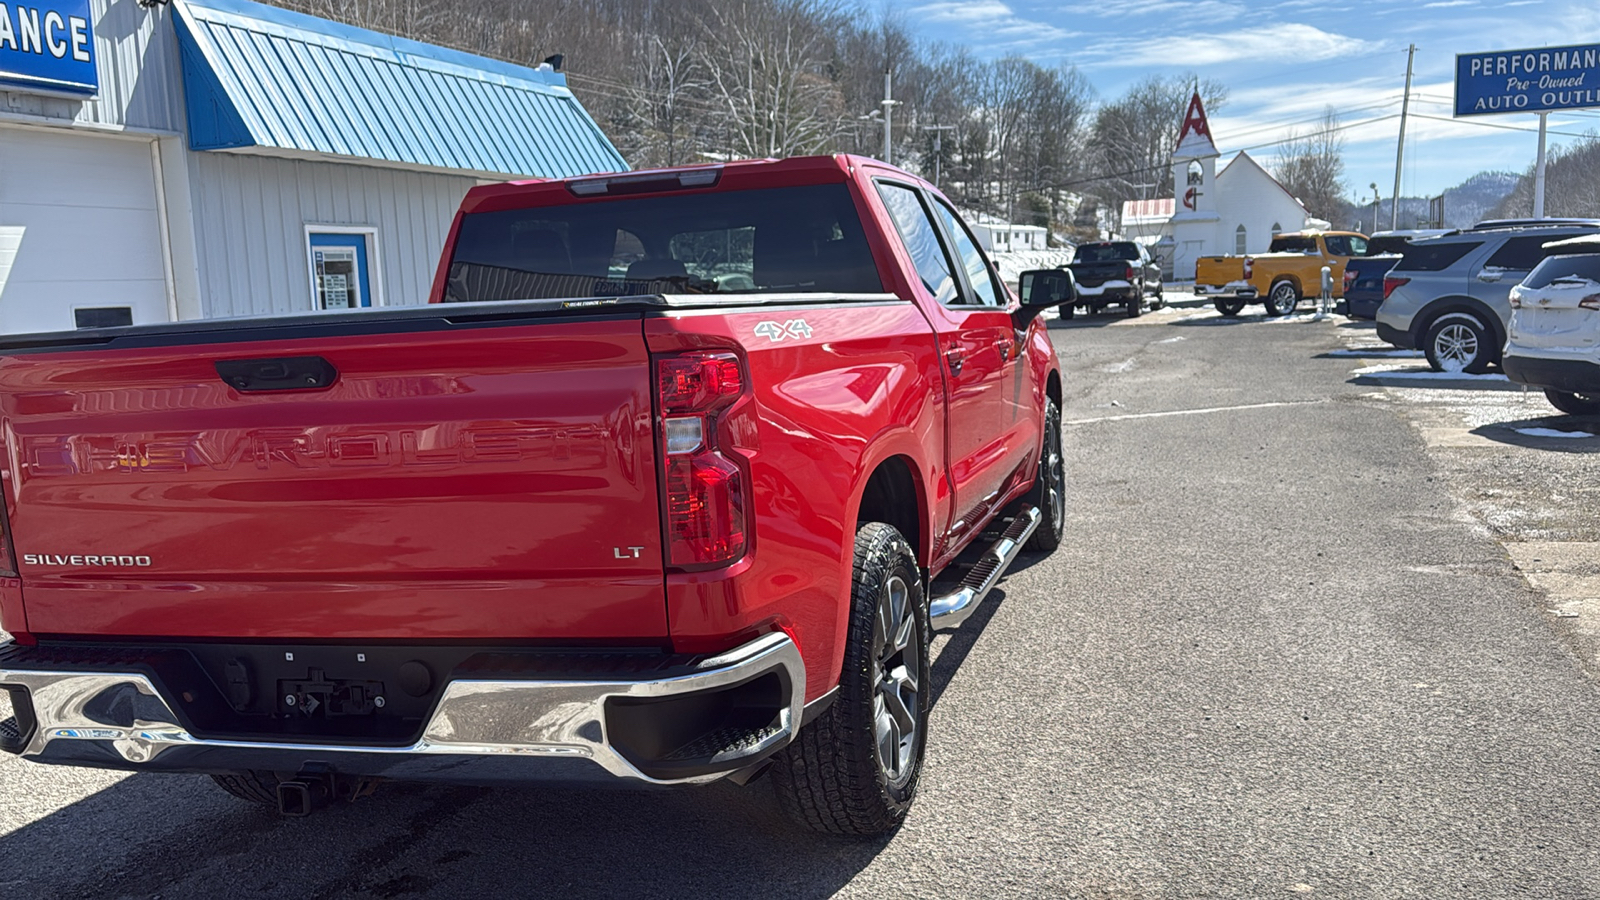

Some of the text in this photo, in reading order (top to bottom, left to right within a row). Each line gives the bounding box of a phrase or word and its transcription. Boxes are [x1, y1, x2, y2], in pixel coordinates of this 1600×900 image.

[0, 2, 91, 62] ANCE
[1471, 49, 1600, 76] PERFORMAN
[1506, 72, 1585, 92] Pre-Owned
[1475, 94, 1528, 110] AUTO
[23, 554, 151, 567] SILVERADO
[613, 546, 645, 559] LT
